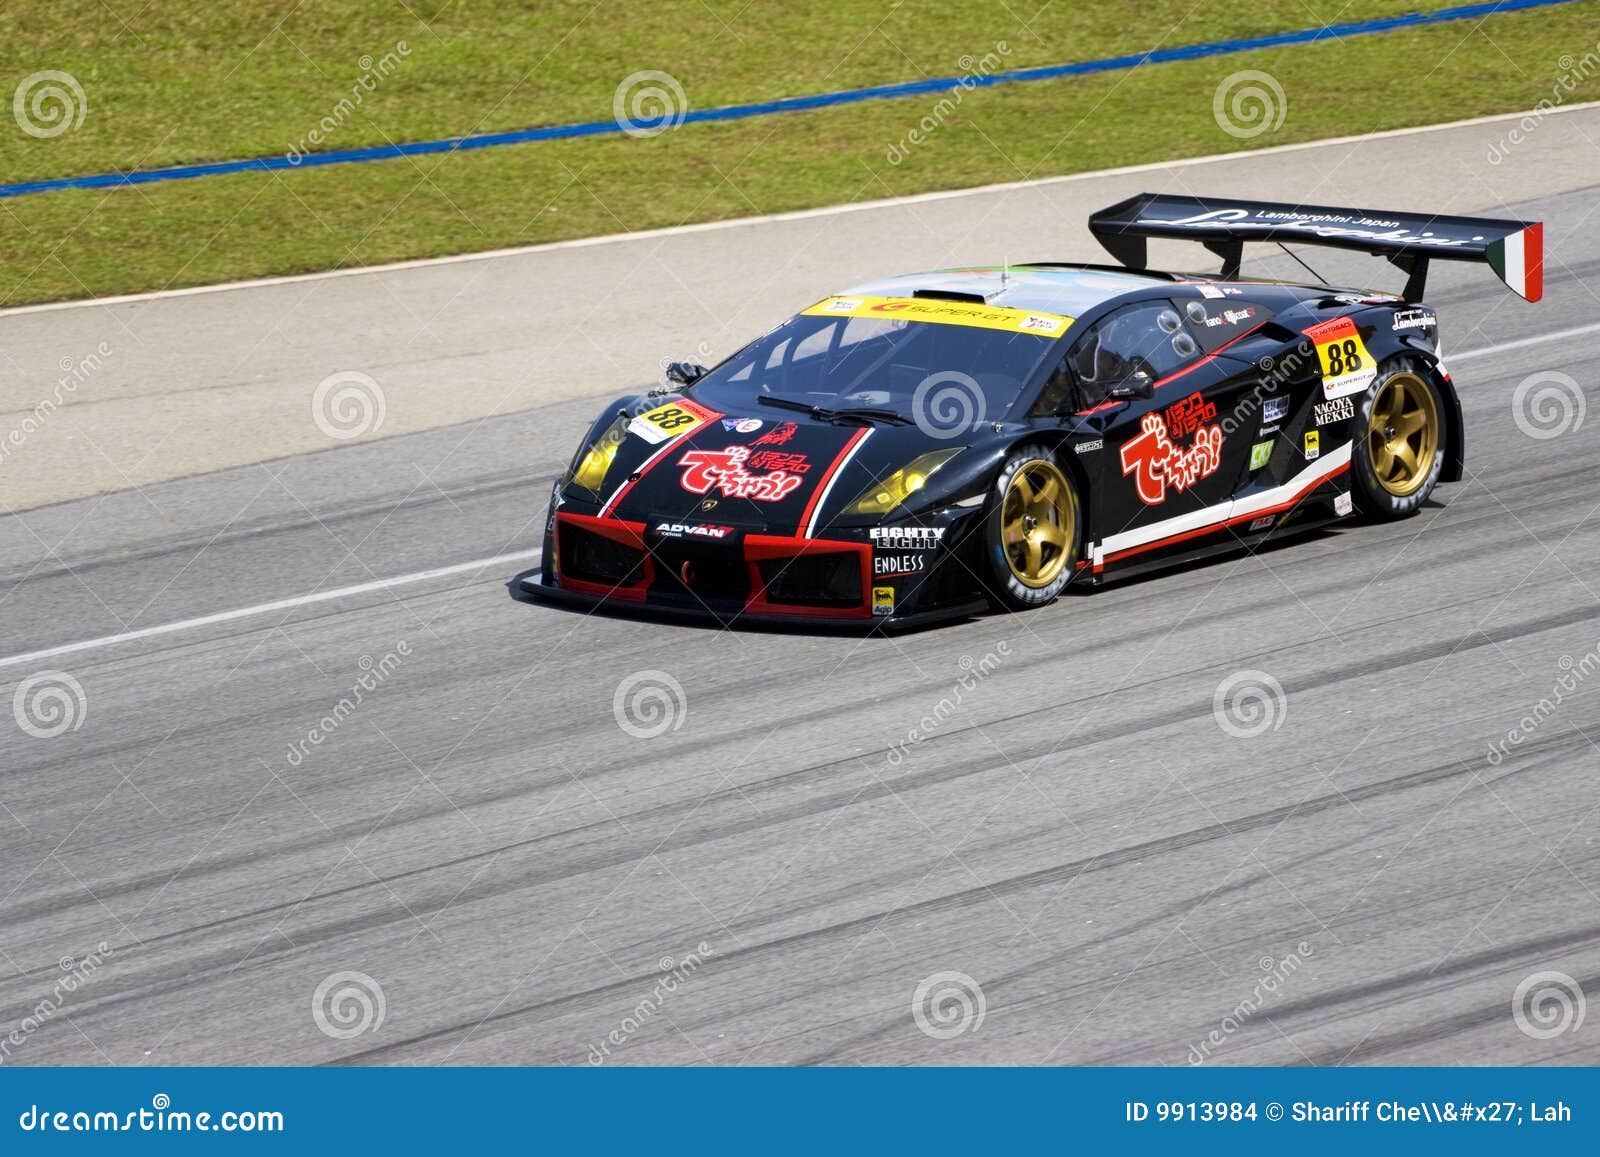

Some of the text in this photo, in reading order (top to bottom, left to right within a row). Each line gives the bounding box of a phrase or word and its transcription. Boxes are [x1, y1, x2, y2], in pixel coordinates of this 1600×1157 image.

[1255, 210, 1400, 229] Lamborghini Japan
[1327, 339, 1362, 377] 88
[1314, 396, 1353, 416] NAGOYA
[647, 408, 695, 429] 88
[1315, 407, 1355, 426] MEKKI
[656, 523, 725, 538] ADVAN
[869, 527, 945, 540] EIGHTY
[876, 536, 937, 549] EIGHT
[874, 554, 924, 574] ENDLESS
